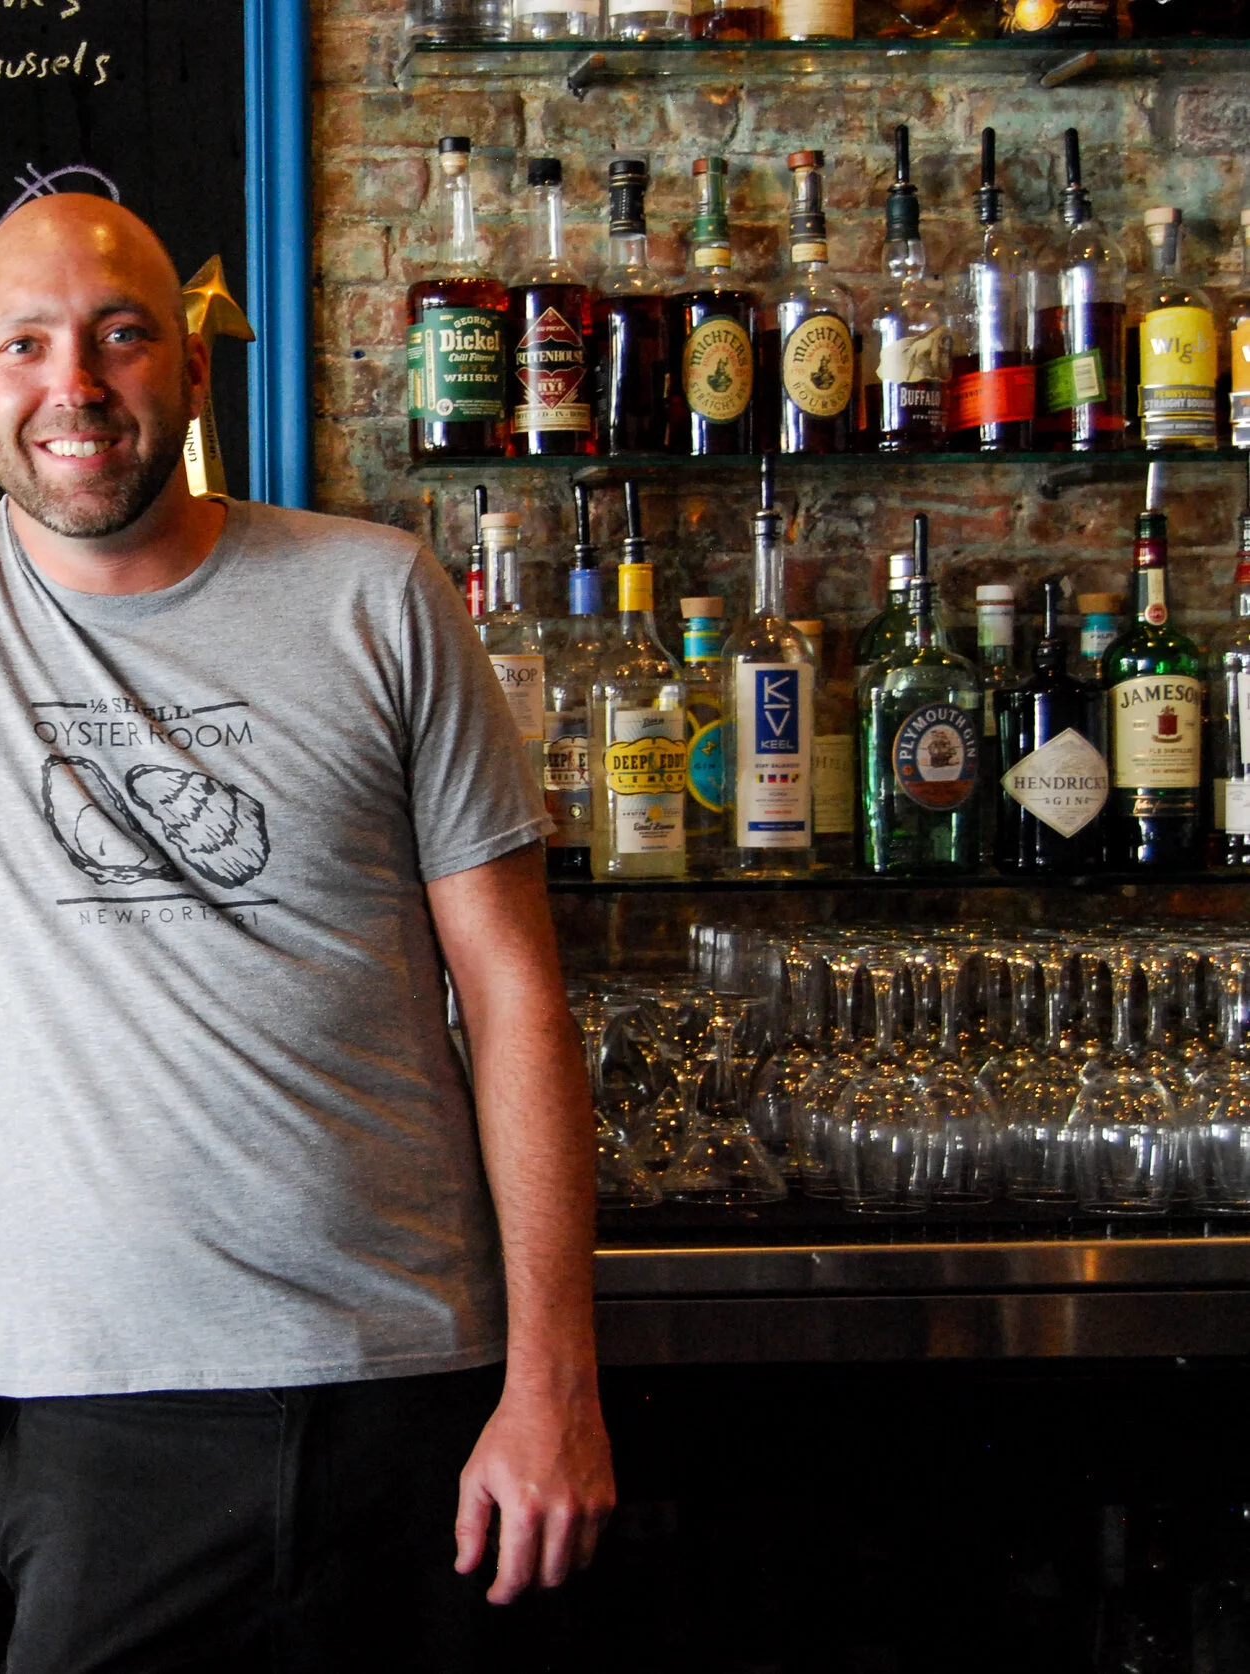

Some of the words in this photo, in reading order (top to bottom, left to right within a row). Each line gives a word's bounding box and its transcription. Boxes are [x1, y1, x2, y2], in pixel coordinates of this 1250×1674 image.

[454, 315, 493, 329] GEORGE
[439, 328, 501, 352] Dickel
[443, 373, 499, 383] WHISKY
[538, 382, 566, 393] RYE
[33, 720, 142, 747] OYSTER
[149, 719, 254, 751] ROOM
[899, 707, 966, 760] PLYMOUTH
[963, 728, 976, 758] GIN
[760, 739, 795, 750] KEEL
[613, 755, 648, 770] DEEP
[1052, 796, 1083, 806] GIN
